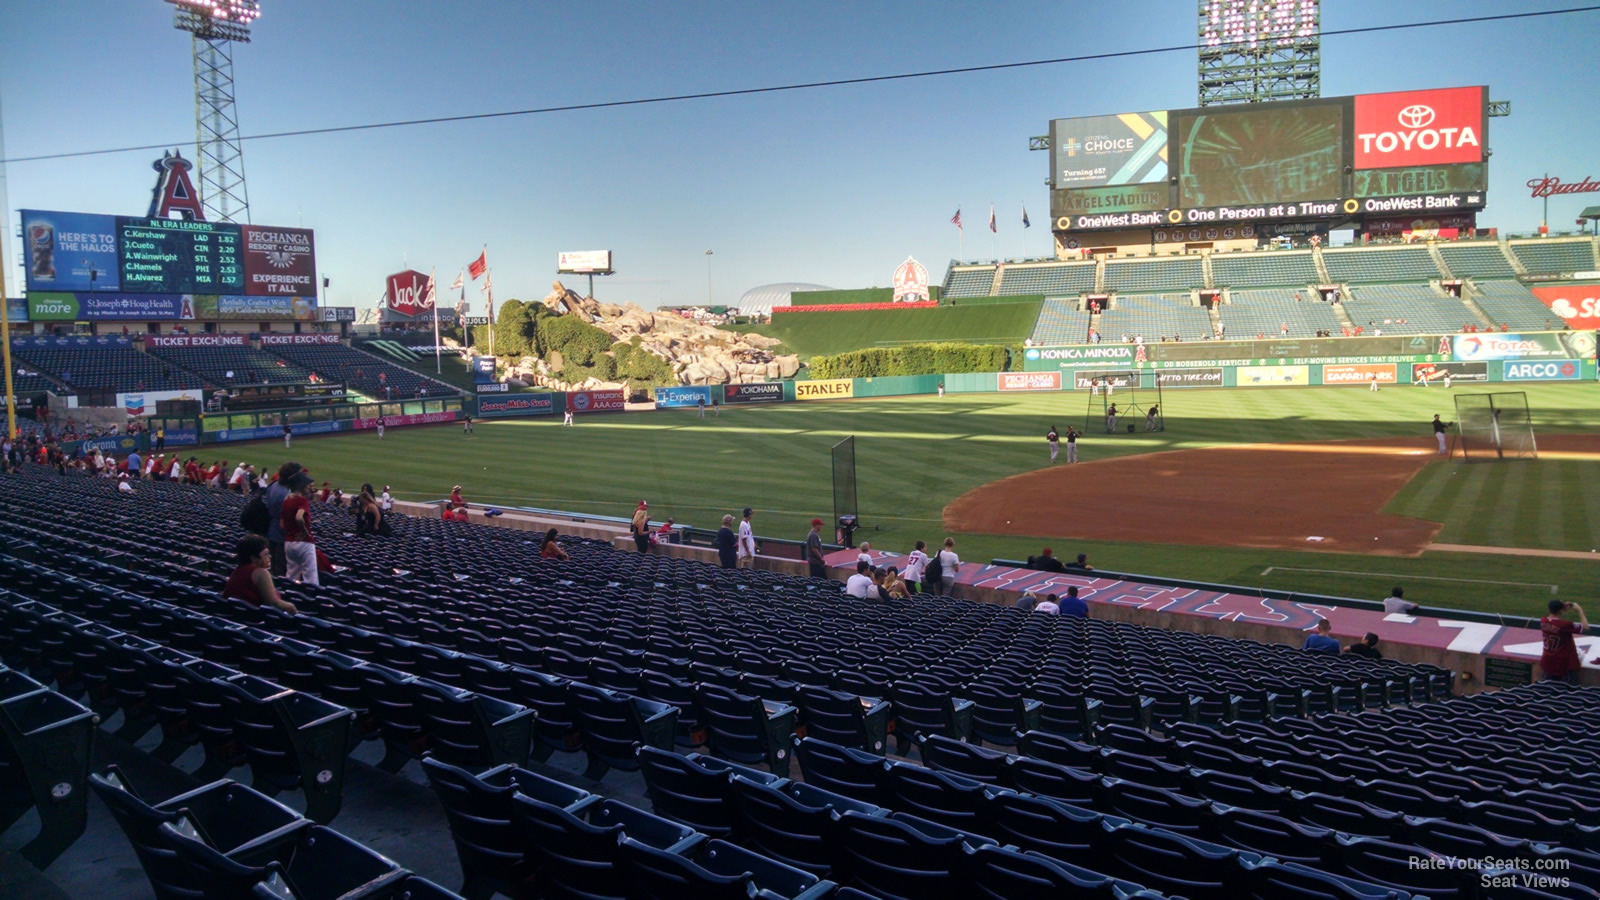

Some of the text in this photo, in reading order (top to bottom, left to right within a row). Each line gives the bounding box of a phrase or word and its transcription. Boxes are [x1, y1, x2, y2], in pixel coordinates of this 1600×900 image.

[1085, 138, 1134, 151] CHOICE
[1358, 126, 1479, 153] TOYOTA
[1365, 169, 1448, 198] ANGELS
[1064, 192, 1160, 210] ANGEL STADIUM
[1365, 196, 1423, 211] OneWest
[1425, 194, 1459, 208] Bank
[1188, 202, 1336, 220] One Person at a Time
[1077, 211, 1160, 228] OneWest Bank
[163, 220, 178, 228] ERA
[179, 221, 213, 231] LEADERS
[58, 232, 114, 244] HERE'S TO
[124, 230, 166, 239] C.Kershaw
[248, 230, 310, 245] PECHANGA
[59, 242, 79, 251] THE
[81, 243, 115, 253] HALOS
[125, 241, 154, 249] J.Cueto
[194, 244, 209, 252] CIN
[248, 243, 310, 253] RESORT CASINO
[125, 252, 178, 262] A.Wainwright
[126, 263, 162, 271] C.Hamels
[195, 265, 210, 273] PHI
[126, 273, 163, 281] H.Alvarez
[196, 275, 211, 283] MIA
[252, 274, 310, 284] EXPERIENCE
[268, 284, 297, 293] IT ALL
[391, 275, 432, 309] Jack
[36, 303, 72, 314] more
[153, 337, 189, 346] TICKET
[261, 335, 293, 344] TICKET
[1488, 340, 1541, 350] TOTAL
[1041, 347, 1132, 360] KONICA MINOLTA
[1175, 360, 1216, 368] HOUSEHOLD
[1293, 357, 1336, 365] SELF-MOVING
[1337, 356, 1368, 364] SERVICES
[1369, 355, 1387, 363] THAT
[1507, 363, 1558, 378] ARCO
[1005, 375, 1054, 383] PECHANGA
[797, 383, 851, 396] STANLEY
[669, 391, 706, 403] Experian
[481, 402, 506, 411] Jersey
[531, 399, 551, 407] Subs
[908, 556, 920, 566] 27
